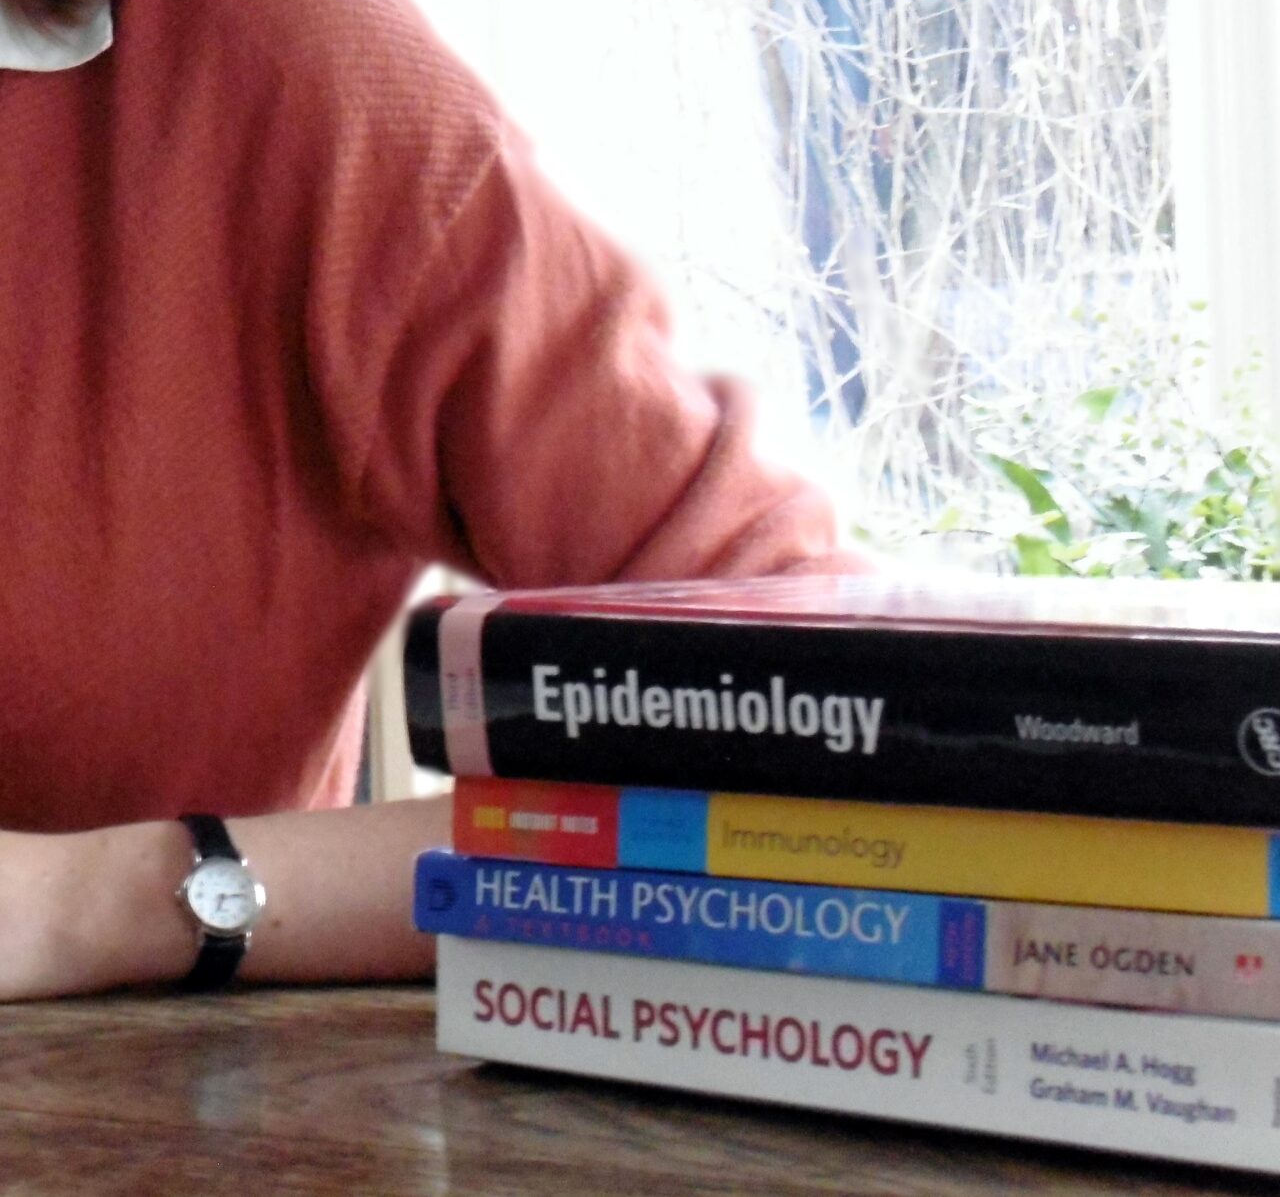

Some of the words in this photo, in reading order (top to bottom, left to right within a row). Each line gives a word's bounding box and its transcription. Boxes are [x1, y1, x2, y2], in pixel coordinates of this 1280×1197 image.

[531, 663, 884, 755] Epidemiology
[1015, 714, 1140, 746] Woodward
[721, 820, 908, 870] Immunology
[475, 868, 618, 919] HEALTH
[630, 881, 911, 945] PSYCHOLOGY
[472, 914, 489, 934] A
[508, 917, 655, 949] TEXTBOOK
[1013, 938, 1077, 967] JANE
[1090, 943, 1195, 976] OGDEN
[473, 979, 621, 1039] SOCIAL
[633, 999, 933, 1080] PSYCHOLOGY
[1030, 1041, 1109, 1071] Michael
[1114, 1052, 1135, 1074] A.
[1142, 1054, 1196, 1088] Hogg
[1029, 1077, 1109, 1107] Graham
[1114, 1088, 1138, 1112] M.
[1146, 1091, 1237, 1124] Vaughan
